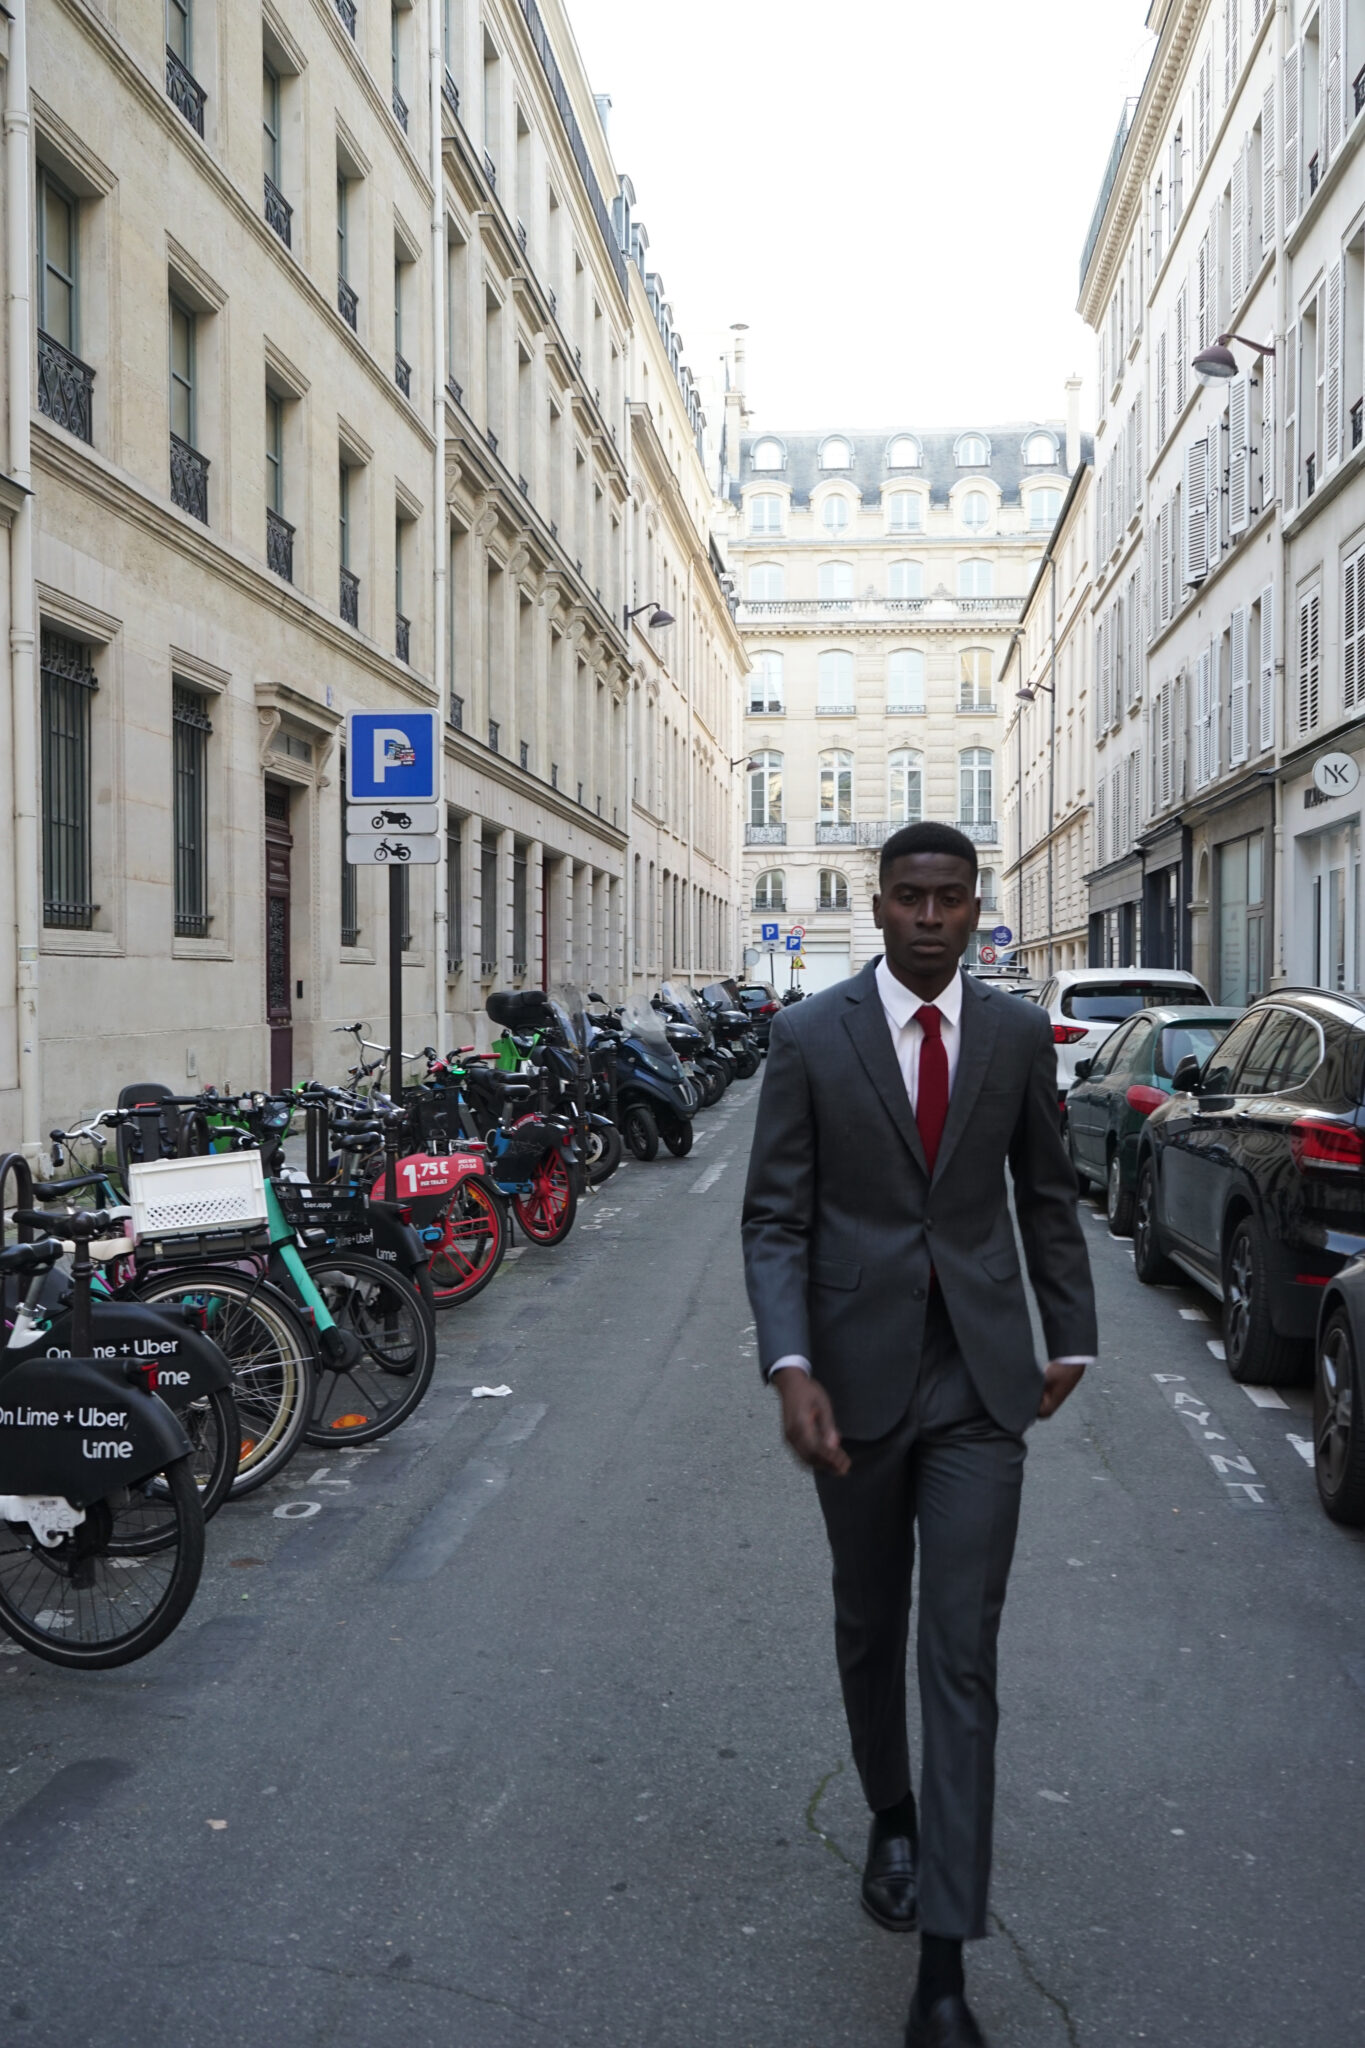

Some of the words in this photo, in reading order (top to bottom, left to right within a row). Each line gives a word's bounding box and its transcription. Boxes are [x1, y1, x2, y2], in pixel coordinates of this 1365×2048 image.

[373, 728, 412, 783] P
[766, 926, 775, 938] P
[376, 1248, 397, 1261] Lime
[134, 1339, 178, 1356] Uber
[157, 1371, 191, 1386] me
[17, 1407, 59, 1426] Lime
[78, 1408, 127, 1427] Uber
[82, 1439, 133, 1459] Lime
